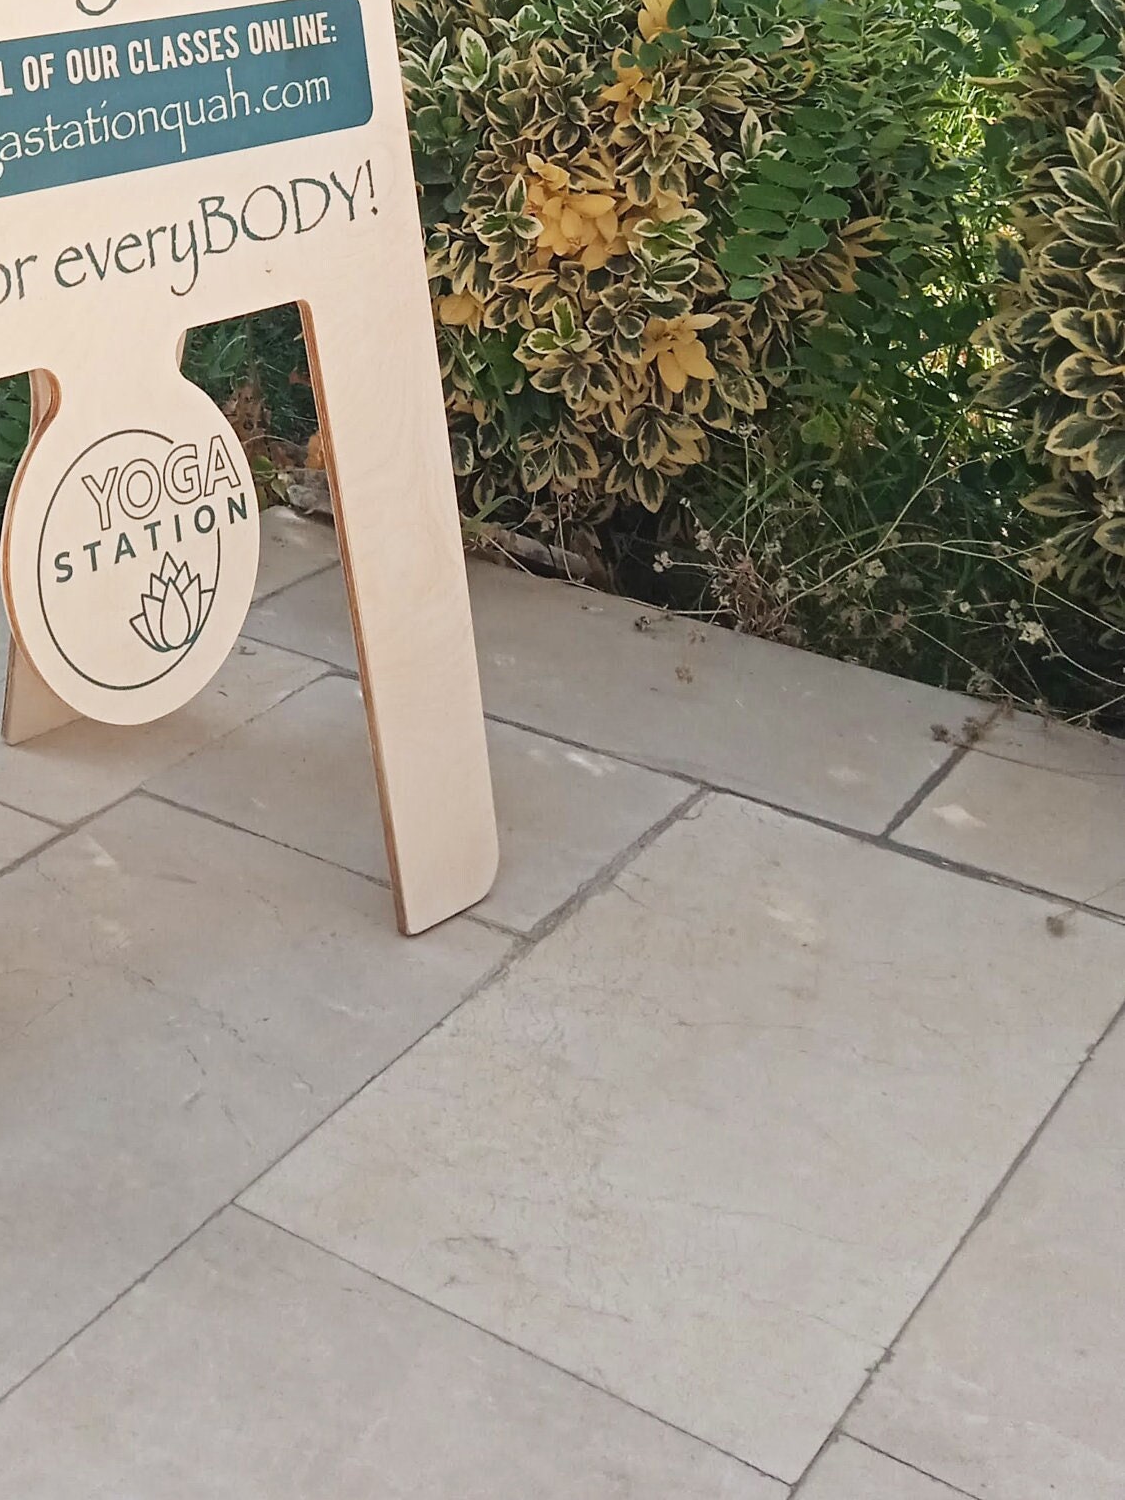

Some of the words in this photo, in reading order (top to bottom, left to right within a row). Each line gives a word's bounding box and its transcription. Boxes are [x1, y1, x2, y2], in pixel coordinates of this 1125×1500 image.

[21, 55, 54, 91] OF
[66, 45, 119, 85] OUR
[127, 29, 241, 74] CLASSES
[247, 11, 337, 54] ONLINE:
[54, 160, 379, 296] everyBODY!
[81, 435, 241, 531] YOGA
[53, 492, 247, 583] STATION
